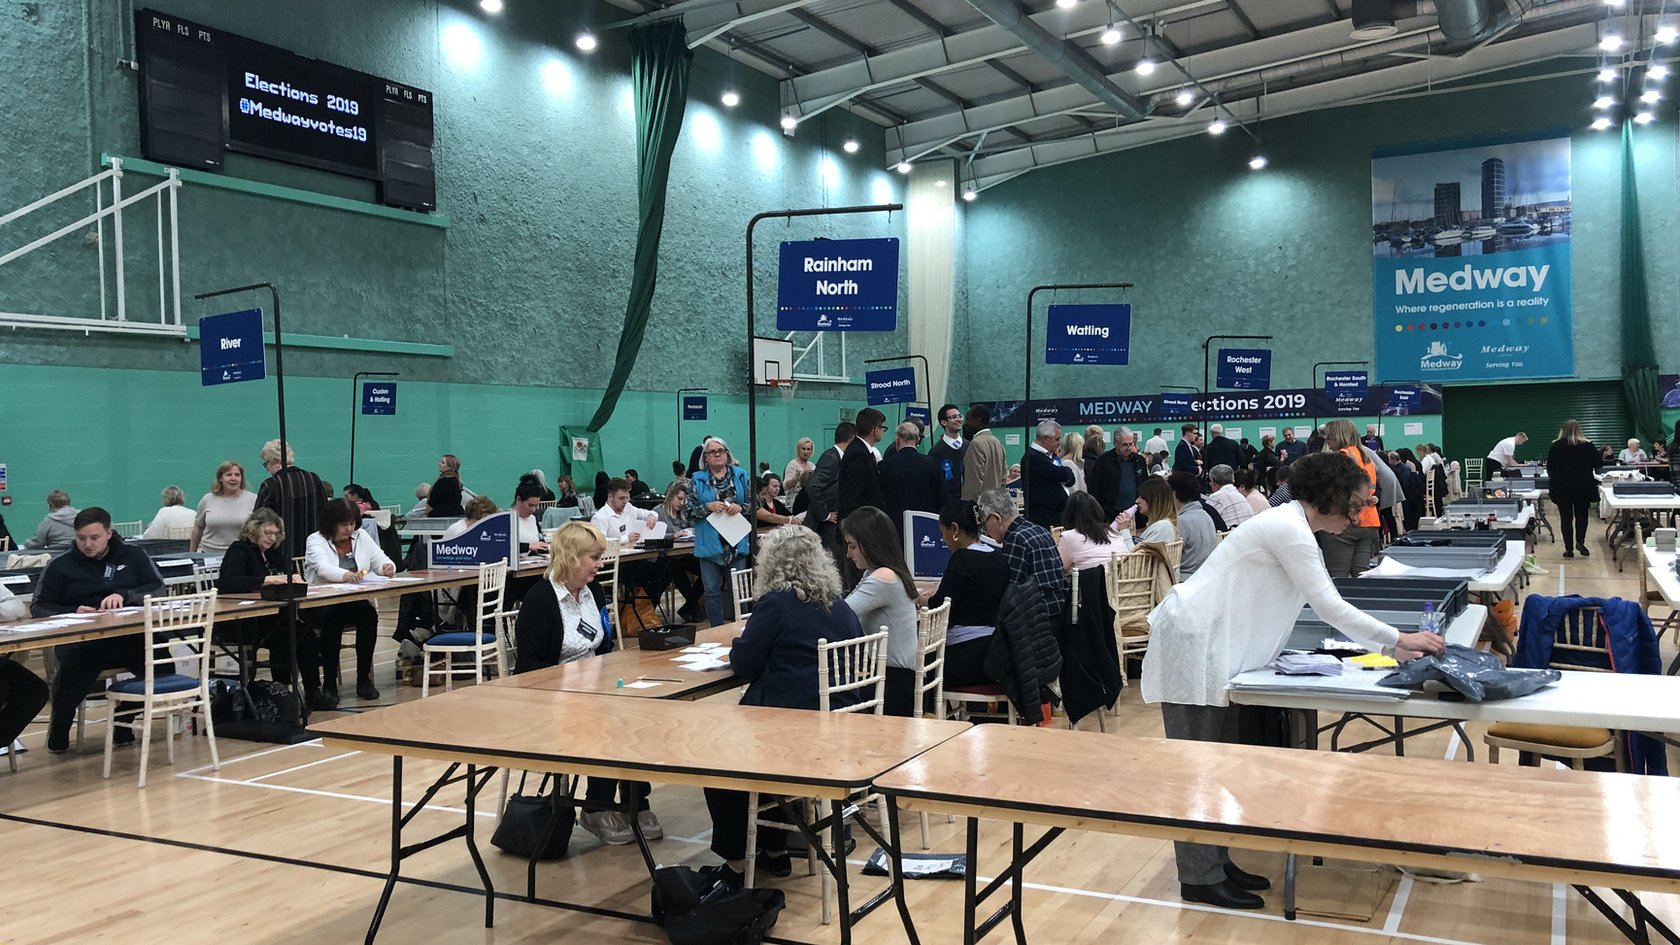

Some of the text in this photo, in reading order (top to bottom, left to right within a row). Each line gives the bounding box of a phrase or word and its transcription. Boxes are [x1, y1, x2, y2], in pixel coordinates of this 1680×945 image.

[152, 16, 211, 43] PLYR FLS PTS
[244, 71, 359, 115] Elections 2019
[385, 83, 428, 104] PLYR FLS PTS
[239, 97, 367, 142] #Medwayvotes19
[803, 256, 873, 273] Rainham
[1395, 264, 1550, 295] Medway
[815, 279, 858, 295] North
[1395, 305, 1427, 314] Where
[1429, 300, 1494, 313] regeneration
[1497, 299, 1505, 308] is
[1517, 297, 1549, 308] reality
[1066, 325, 1109, 338] Watling
[220, 337, 242, 350] River
[1480, 344, 1529, 354] Medway
[1226, 355, 1262, 364] Rochester
[1420, 359, 1462, 370] Medway
[1485, 362, 1509, 370] Serving
[1235, 366, 1252, 374] West
[892, 379, 911, 387] North
[1079, 394, 1306, 416] MEDWAY ections 2019
[436, 544, 478, 557] Medway
